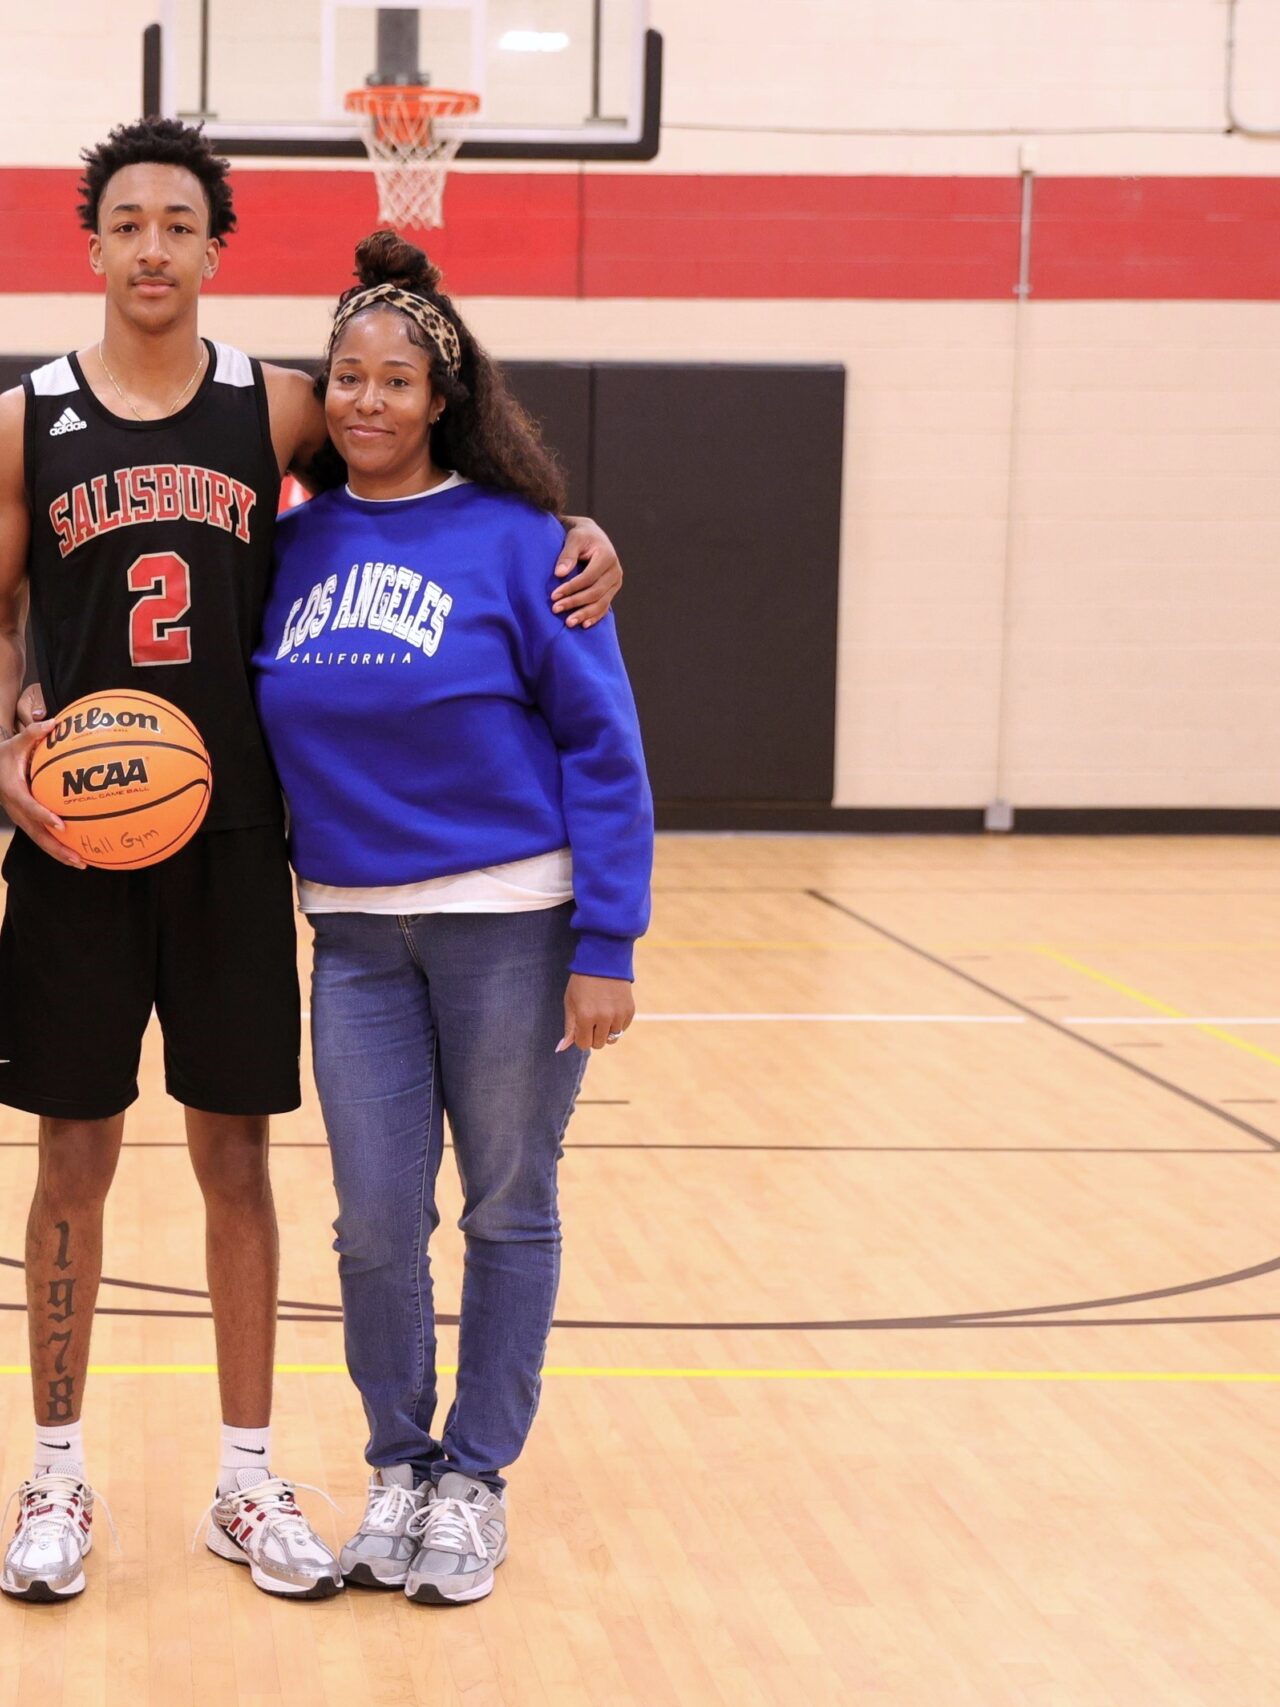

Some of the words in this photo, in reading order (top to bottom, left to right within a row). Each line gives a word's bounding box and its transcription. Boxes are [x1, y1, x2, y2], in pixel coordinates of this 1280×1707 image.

[49, 420, 87, 436] adidas
[49, 464, 256, 559] SALISBURY
[127, 551, 191, 667] 2
[275, 574, 337, 660] LOS
[331, 562, 453, 657] ANGELES
[290, 652, 411, 665] CALIFORNIA
[46, 707, 160, 749] Wilson
[62, 758, 148, 797] NCAA
[99, 791, 124, 799] GAME
[80, 834, 114, 855] Hall
[120, 828, 160, 849] Gym
[47, 1220, 77, 1421] 1978
